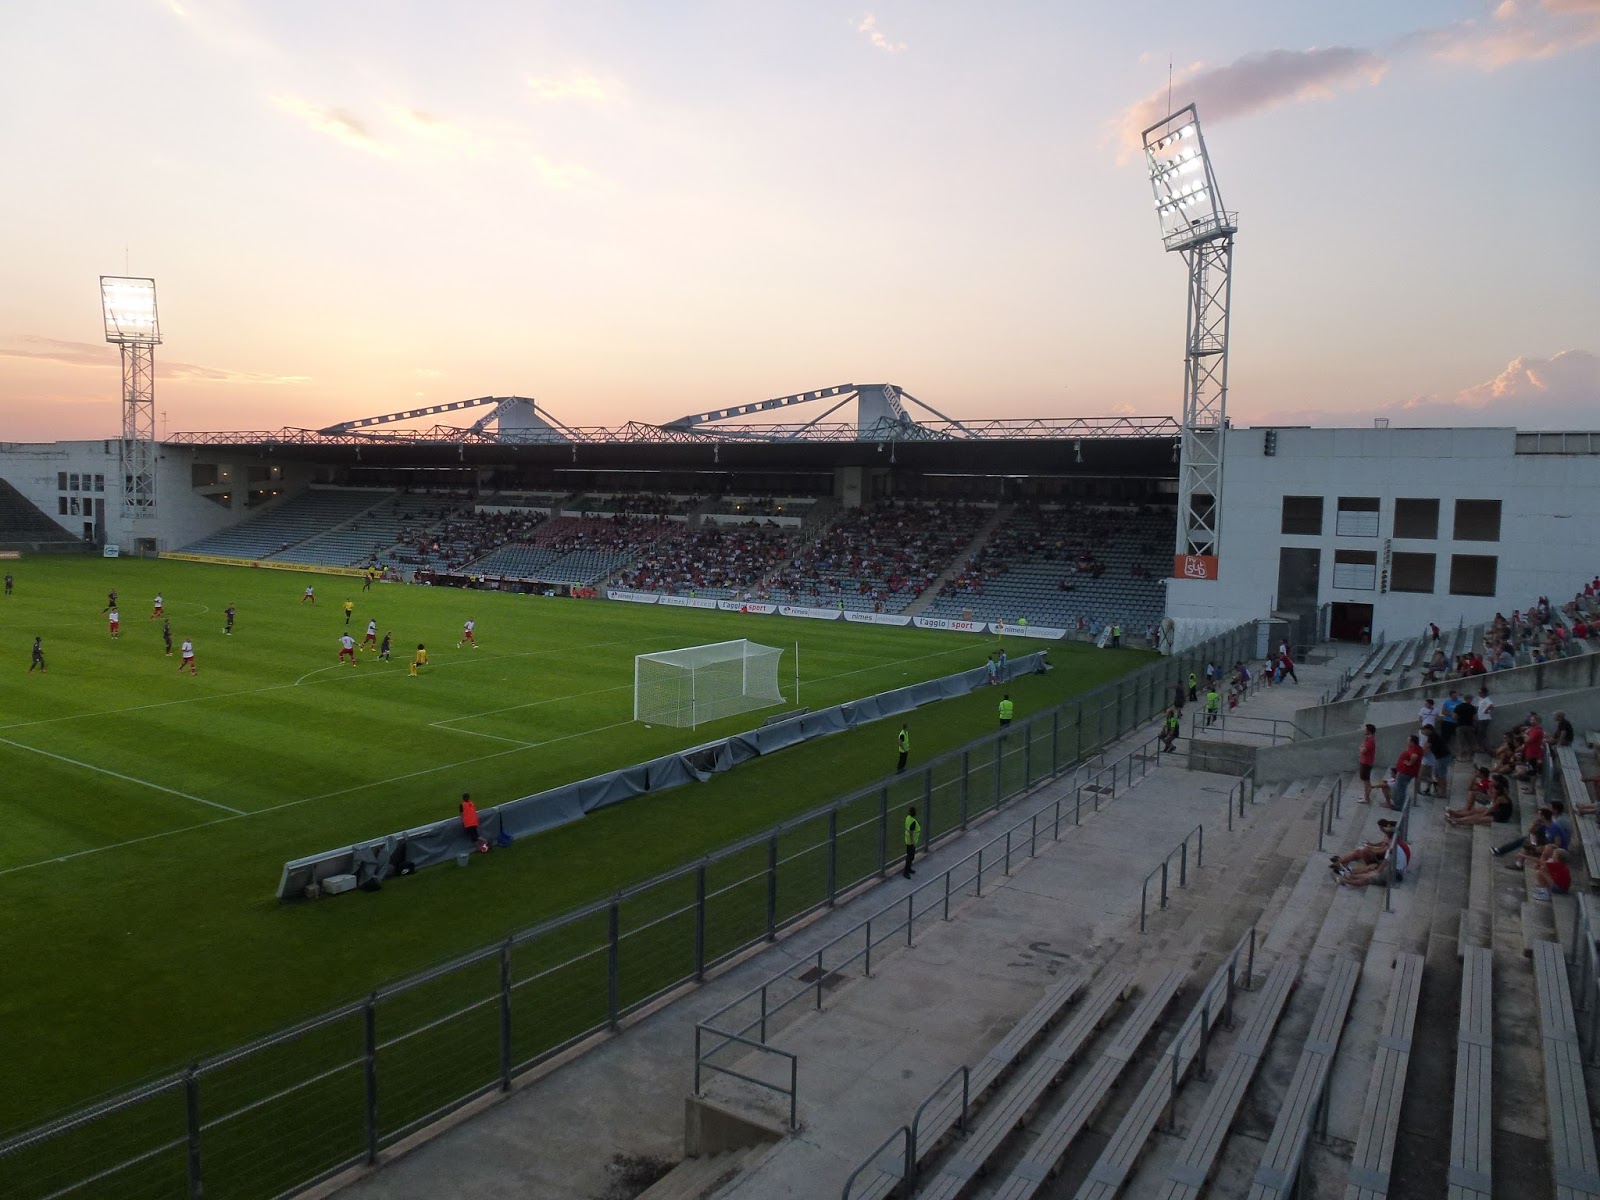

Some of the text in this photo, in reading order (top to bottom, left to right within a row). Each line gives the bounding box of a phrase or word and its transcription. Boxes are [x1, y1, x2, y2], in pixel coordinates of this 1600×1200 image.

[1187, 563, 1206, 576] SUD
[748, 604, 767, 612] sport
[919, 617, 974, 630] l'agglo sport
